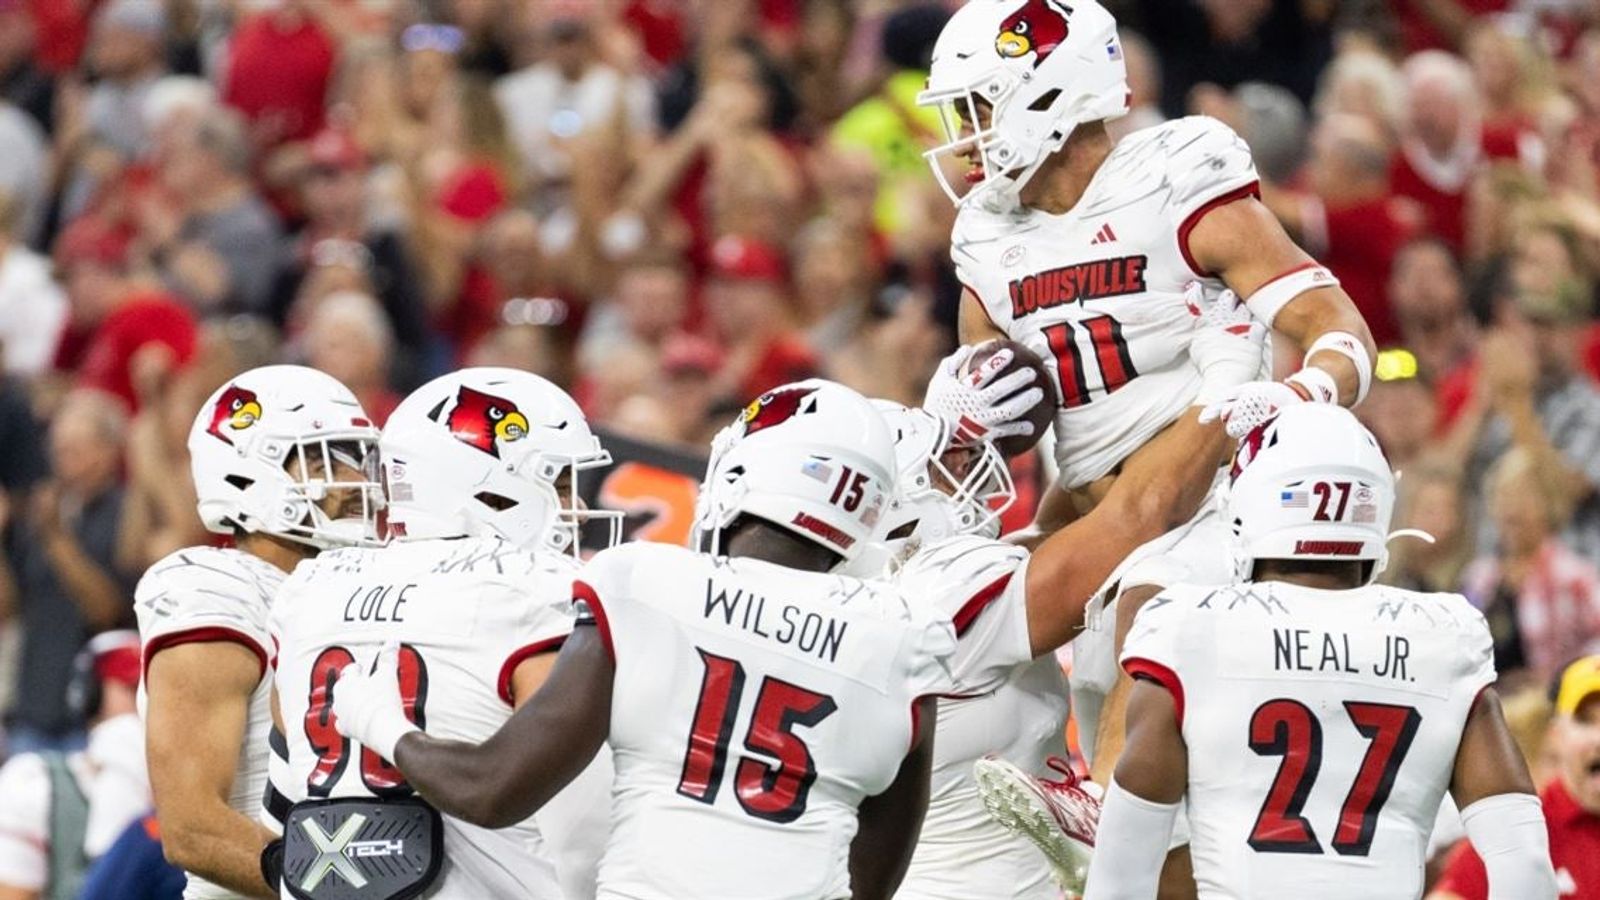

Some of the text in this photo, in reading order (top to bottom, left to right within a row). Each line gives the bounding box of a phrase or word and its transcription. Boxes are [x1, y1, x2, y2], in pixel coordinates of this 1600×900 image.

[1009, 255, 1147, 319] LOUISVILLE
[1040, 314, 1139, 409] 11
[829, 464, 871, 512] 15
[1312, 481, 1352, 522] 27
[344, 584, 417, 622] LOLE
[704, 578, 848, 663] WILSON
[1273, 628, 1416, 682] NEAL JR.
[676, 645, 838, 824] 15
[1246, 697, 1423, 857] 27
